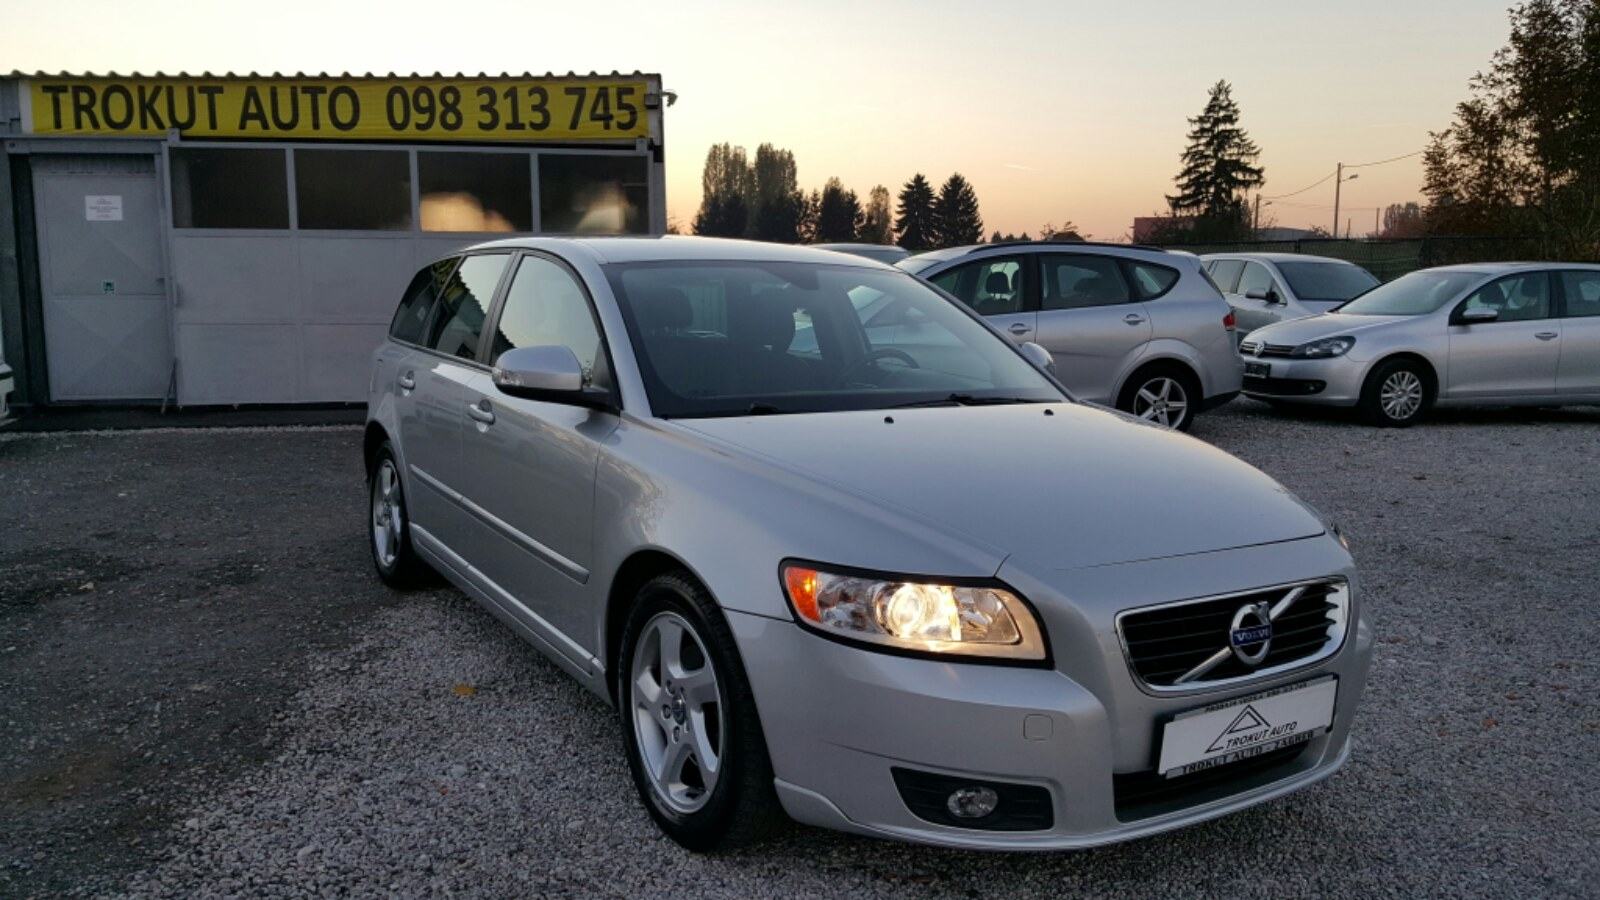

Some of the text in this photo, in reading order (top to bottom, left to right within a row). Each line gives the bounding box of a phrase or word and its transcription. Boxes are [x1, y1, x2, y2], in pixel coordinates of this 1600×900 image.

[42, 84, 638, 131] TROKUT AUTO 098 313 745
[1226, 721, 1298, 749] TROKUT AUTO
